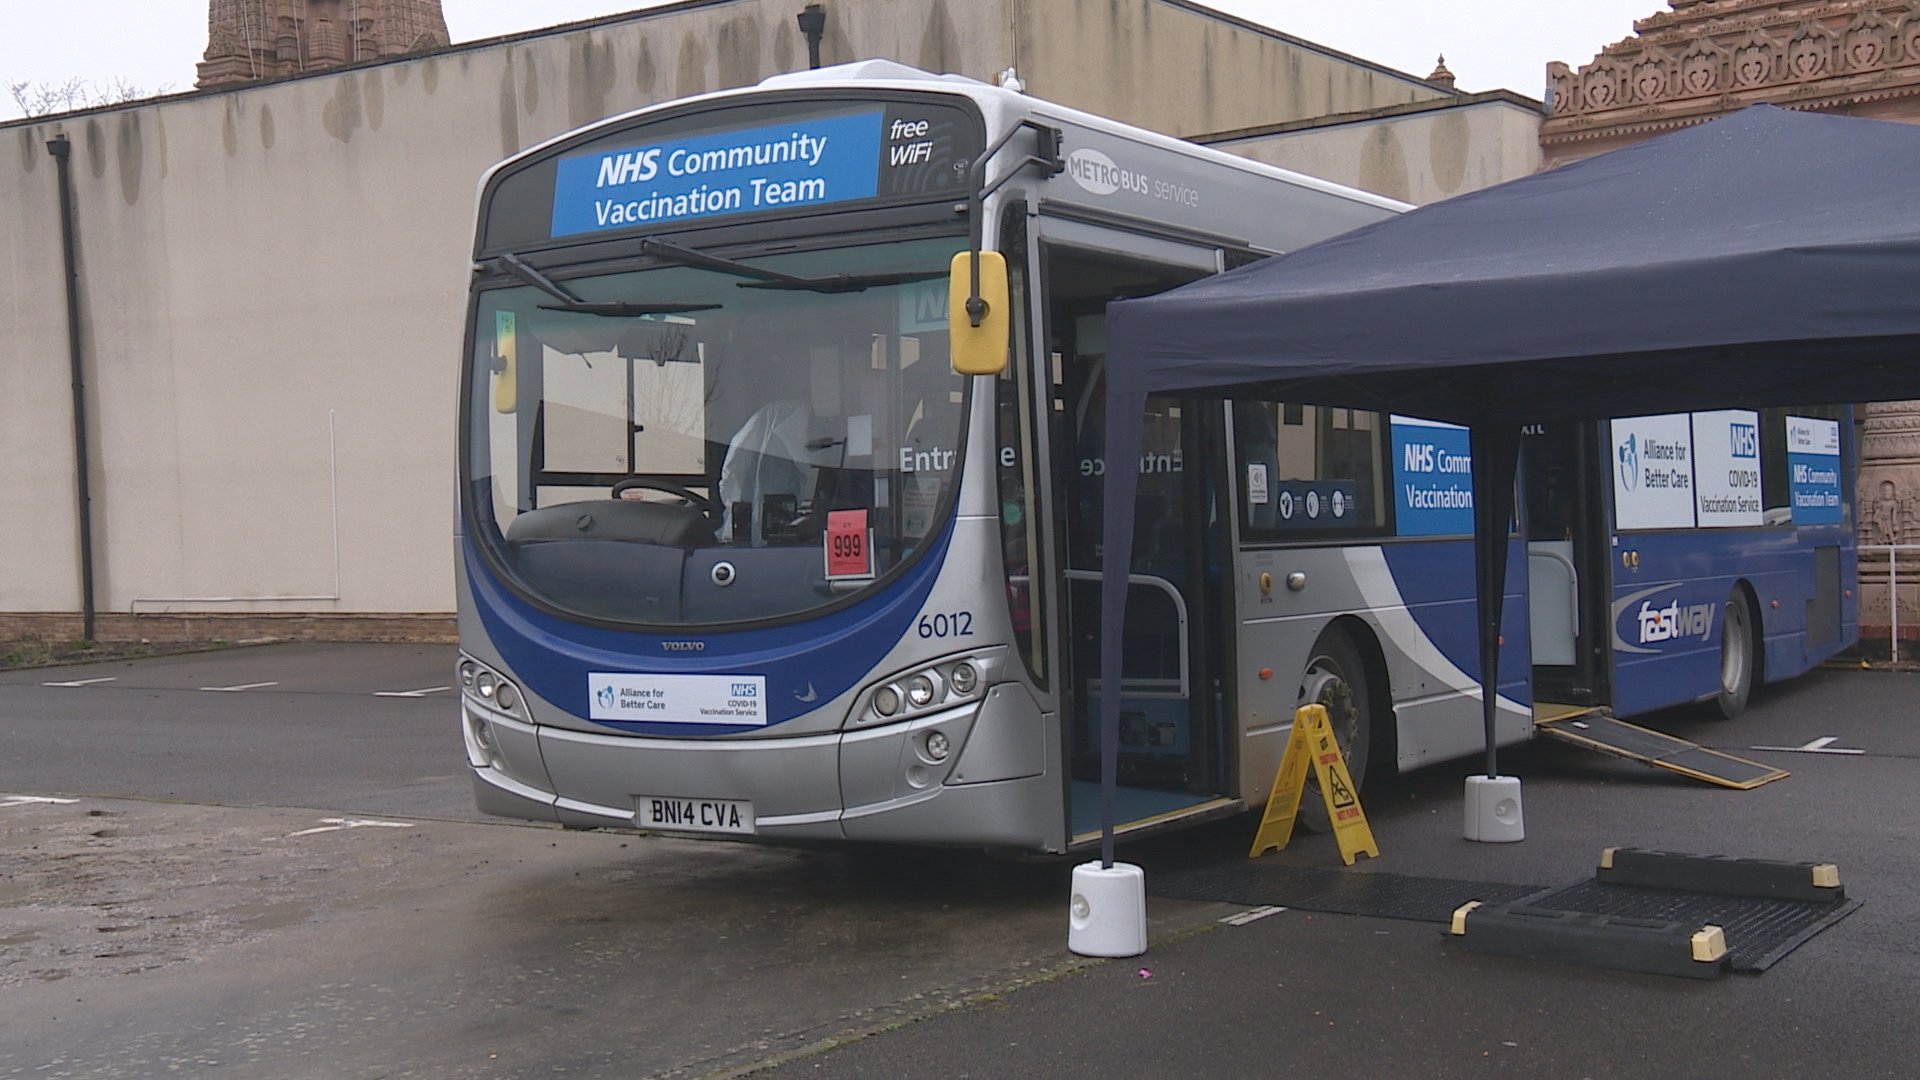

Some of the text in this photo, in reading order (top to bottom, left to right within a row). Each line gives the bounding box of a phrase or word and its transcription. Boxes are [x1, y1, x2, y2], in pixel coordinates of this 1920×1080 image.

[890, 119, 929, 140] free
[596, 133, 828, 188] NHS Community
[890, 141, 933, 167] WiFi
[594, 175, 826, 227] Vaccination Team
[1154, 180, 1199, 207] service
[1644, 439, 1686, 461] Alliance for
[1731, 424, 1756, 458] NHS
[1404, 443, 1434, 473] NHS
[1645, 468, 1689, 488] Better Care
[1728, 470, 1758, 488] COVID-19
[1793, 464, 1837, 488] NHS Community
[1406, 483, 1473, 509] Vaccination
[1700, 495, 1760, 513] Vaccination Service
[1794, 490, 1839, 507] Vaccination Team
[834, 534, 861, 558] 999
[918, 611, 973, 638] 6012
[1638, 599, 1716, 643] fastway
[661, 641, 705, 651] VOLVO
[620, 688, 664, 698] Alliance for
[731, 684, 757, 697] NHS
[620, 699, 666, 710] Better Care
[700, 707, 757, 716] Vaccination Service
[727, 700, 757, 708] COVID-19
[651, 800, 741, 828] BN14 CVA
